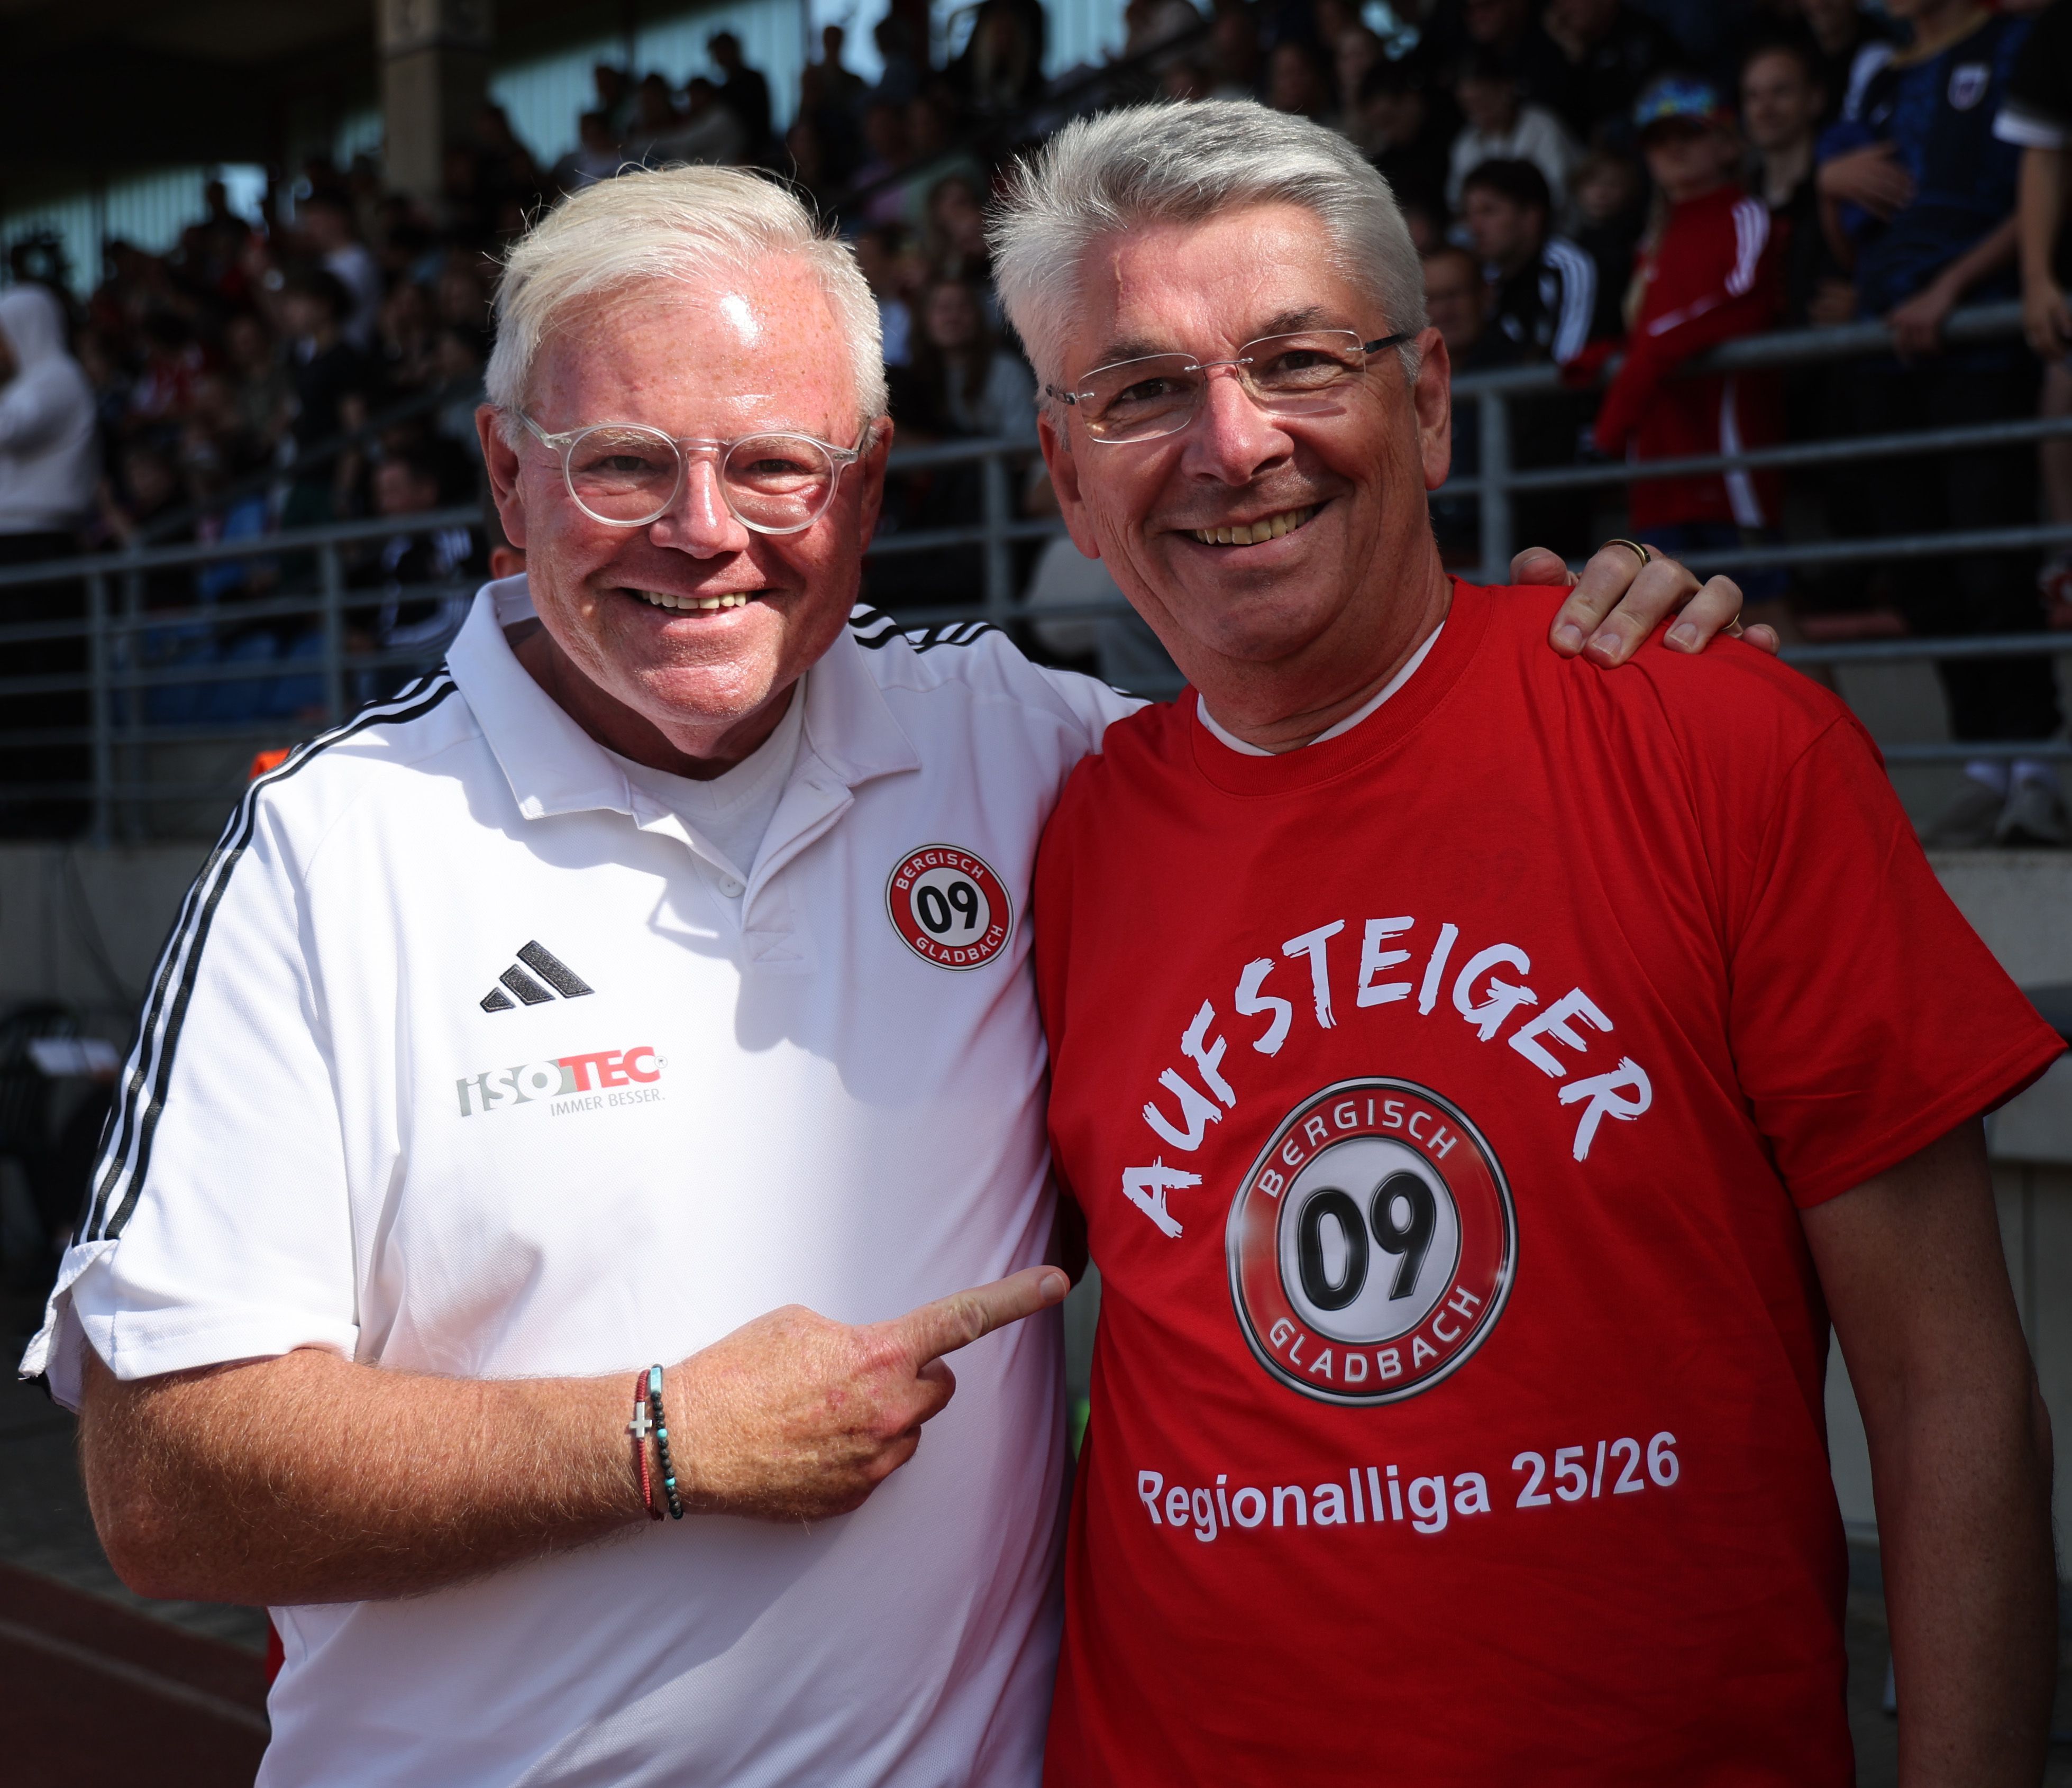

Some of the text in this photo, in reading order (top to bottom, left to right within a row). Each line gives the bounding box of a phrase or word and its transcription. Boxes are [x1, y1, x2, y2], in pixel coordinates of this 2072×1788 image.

[896, 852, 984, 890] BERGISCH
[917, 881, 978, 934] 09
[916, 925, 1003, 963] GLADBACH
[550, 1088, 665, 1116] IMMER BESSER.
[1122, 916, 1653, 1238] AUFSTEIGER
[1257, 1098, 1457, 1198] BERGISCH
[1297, 1171, 1437, 1311] 09
[1268, 1285, 1482, 1382] GLADBACH
[1137, 1431, 1681, 1543] Regionalliga 25/26
